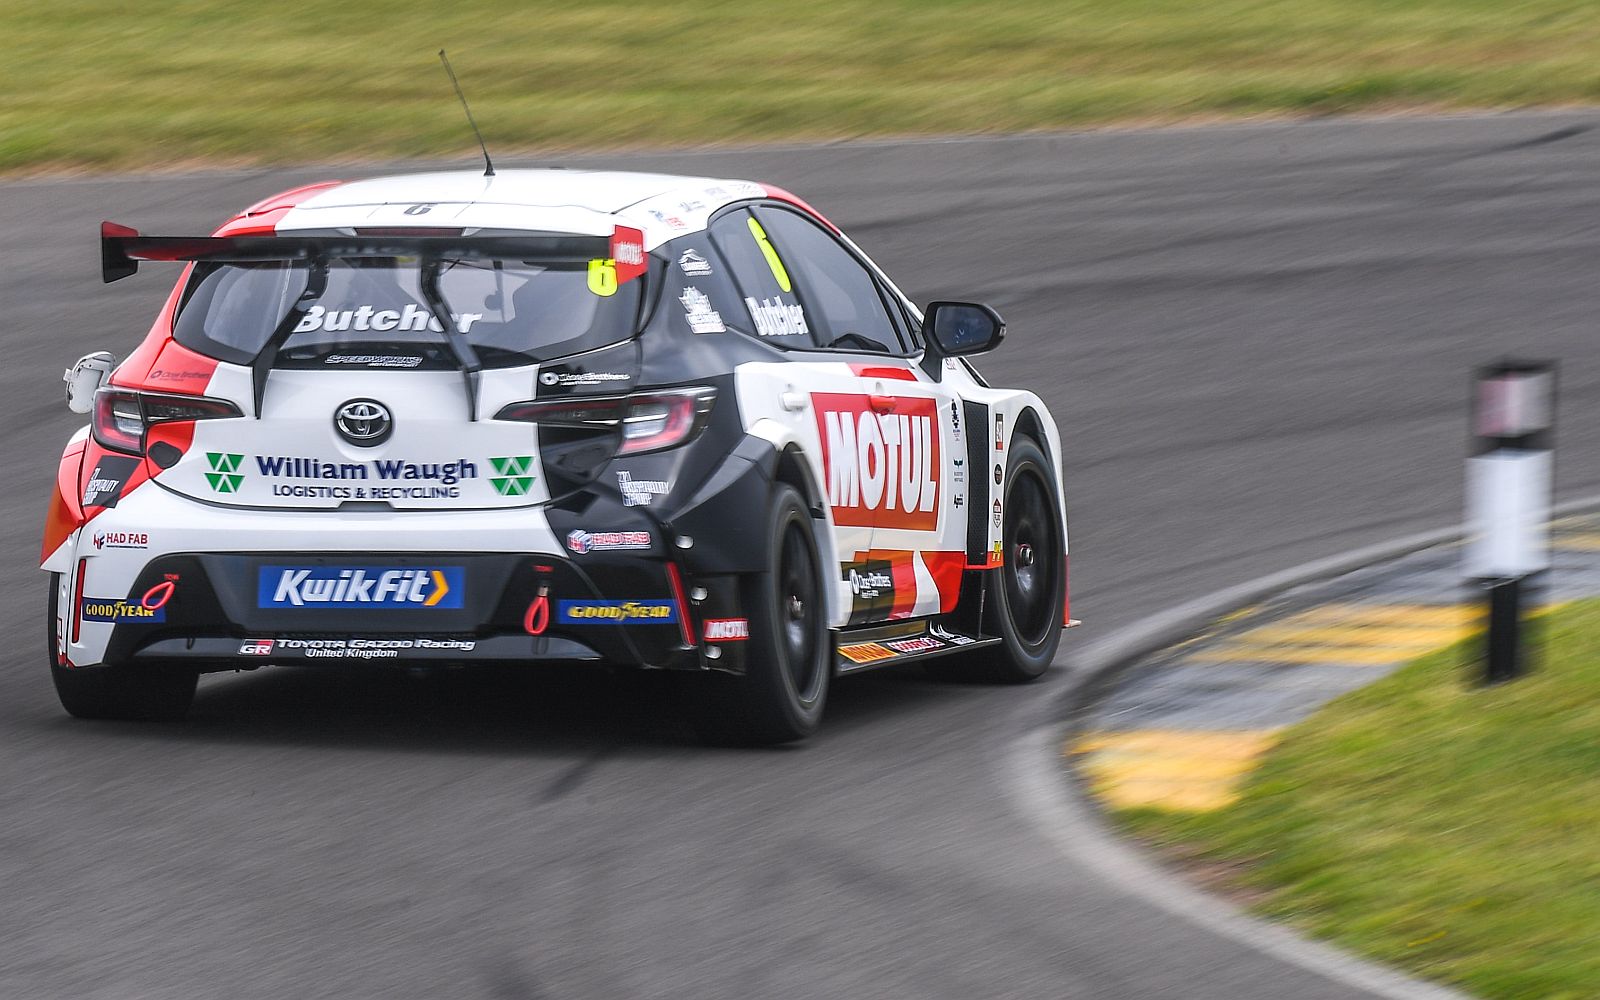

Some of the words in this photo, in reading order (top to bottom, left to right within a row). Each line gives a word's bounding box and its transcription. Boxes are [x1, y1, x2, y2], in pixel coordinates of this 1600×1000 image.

[744, 296, 809, 336] Butcher
[823, 410, 937, 514] MOTUL
[255, 455, 368, 479] William
[373, 458, 477, 485] Waugh
[273, 485, 351, 498] LOGISTICS
[355, 487, 367, 498] &
[370, 486, 460, 499] RECYCLING
[106, 533, 126, 544] HAD
[128, 533, 148, 545] FAB
[240, 644, 272, 655] GR
[275, 639, 346, 649] TOYOTA
[348, 639, 413, 648] GAZOO
[414, 638, 477, 652] Racing
[305, 647, 345, 658] United
[345, 648, 398, 659] Kingdom
